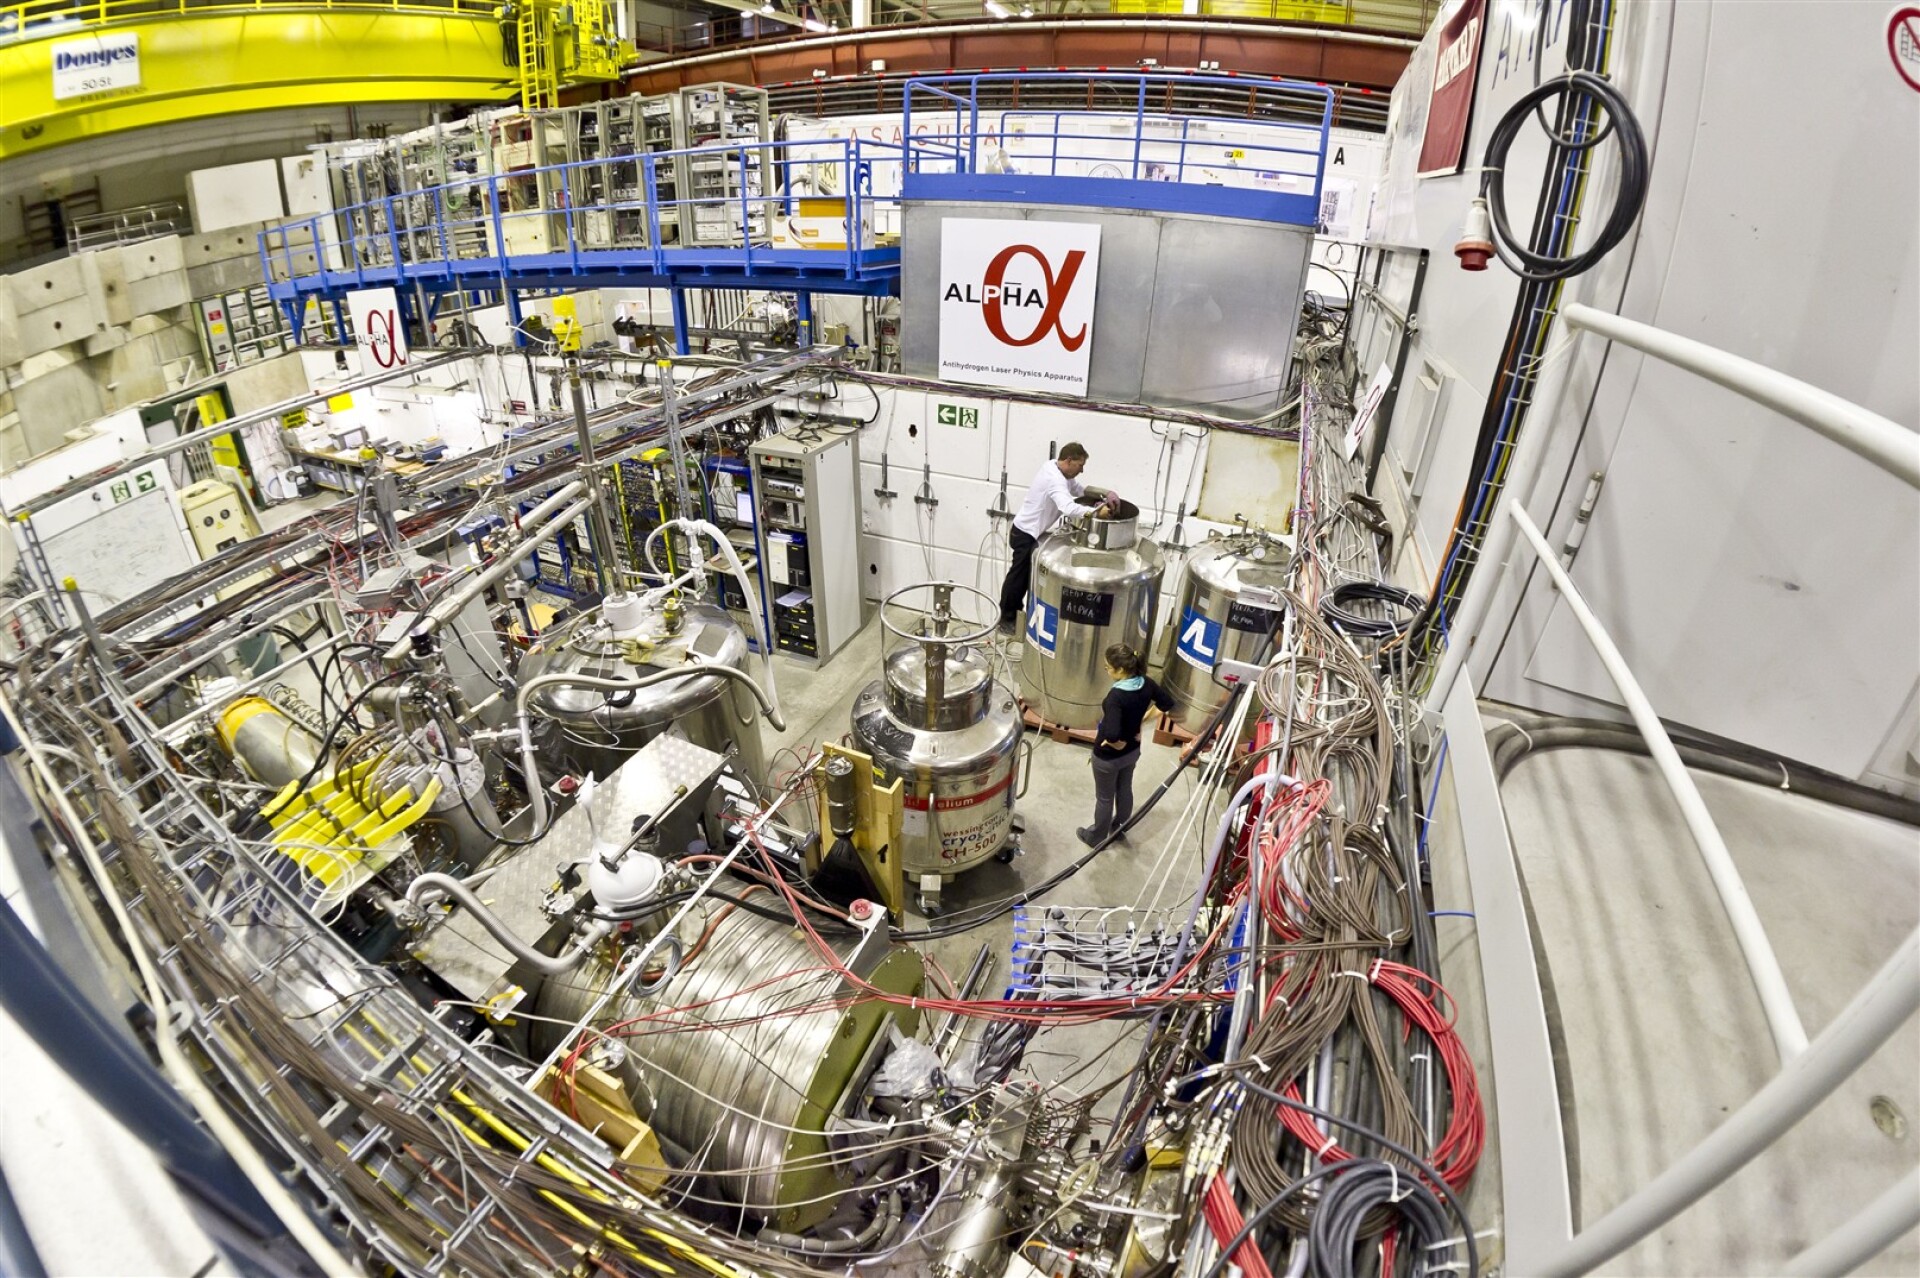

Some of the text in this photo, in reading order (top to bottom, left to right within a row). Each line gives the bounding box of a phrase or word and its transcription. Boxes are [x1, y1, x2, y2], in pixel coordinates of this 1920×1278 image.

[57, 45, 135, 70] Donges
[942, 360, 1083, 383] Antihydrogen Laser Physics Apparatus
[937, 797, 974, 809] elium
[941, 834, 998, 860] CH-500
